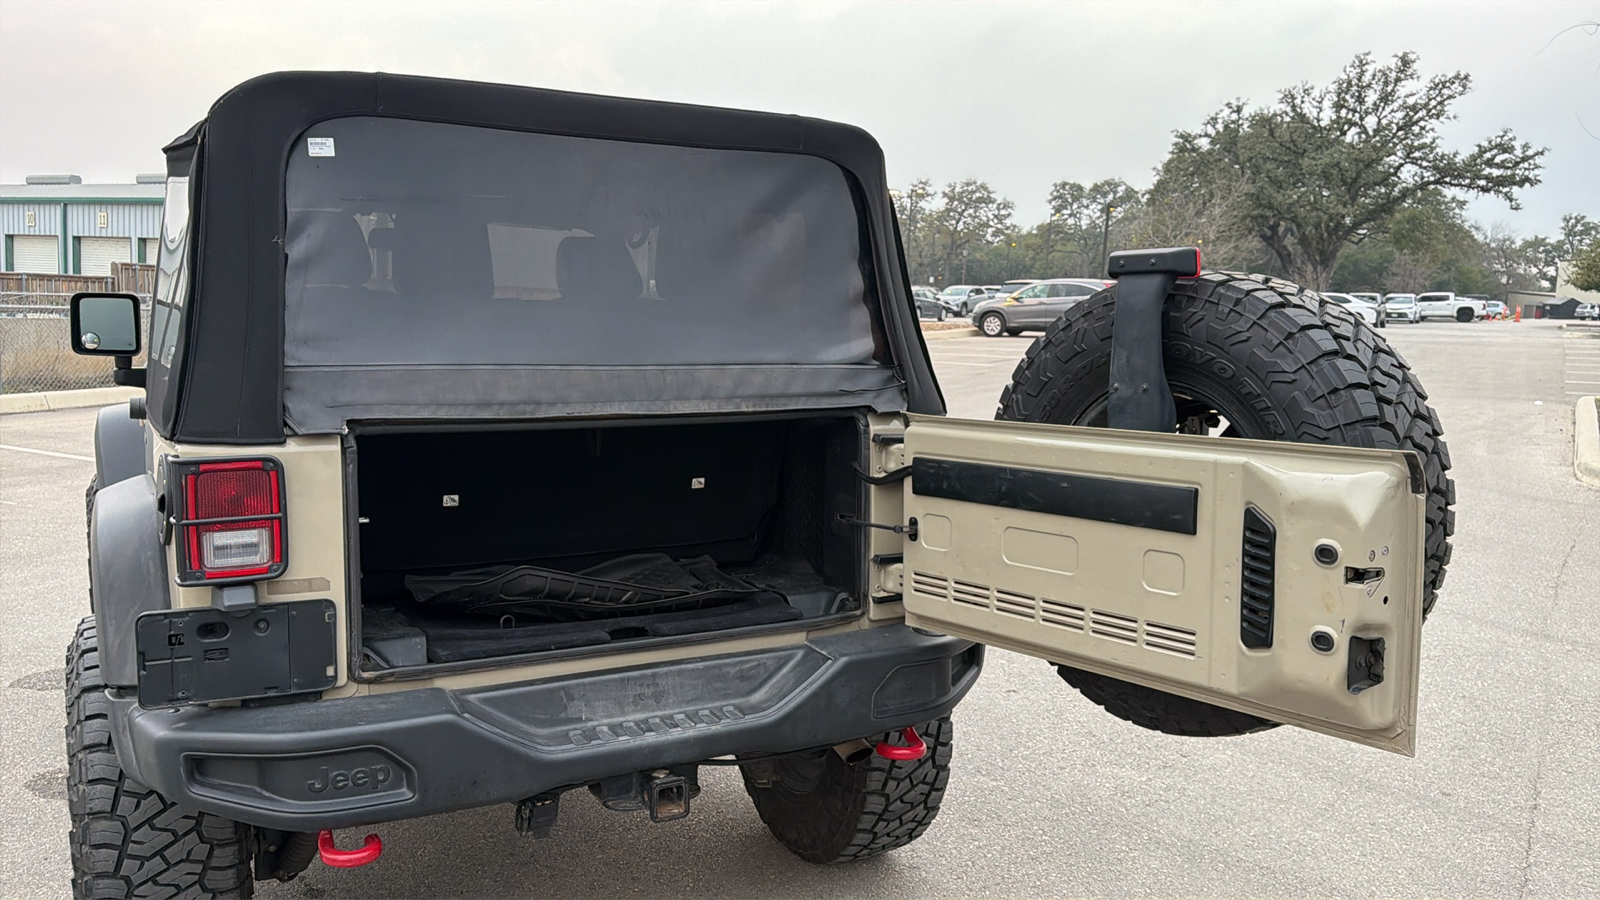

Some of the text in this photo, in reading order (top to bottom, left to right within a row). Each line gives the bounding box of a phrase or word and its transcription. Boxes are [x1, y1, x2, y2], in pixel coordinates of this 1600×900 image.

[27, 213, 34, 224] 10
[99, 214, 106, 225] 11
[1163, 340, 1236, 379] OYO
[306, 764, 392, 793] Jeep
